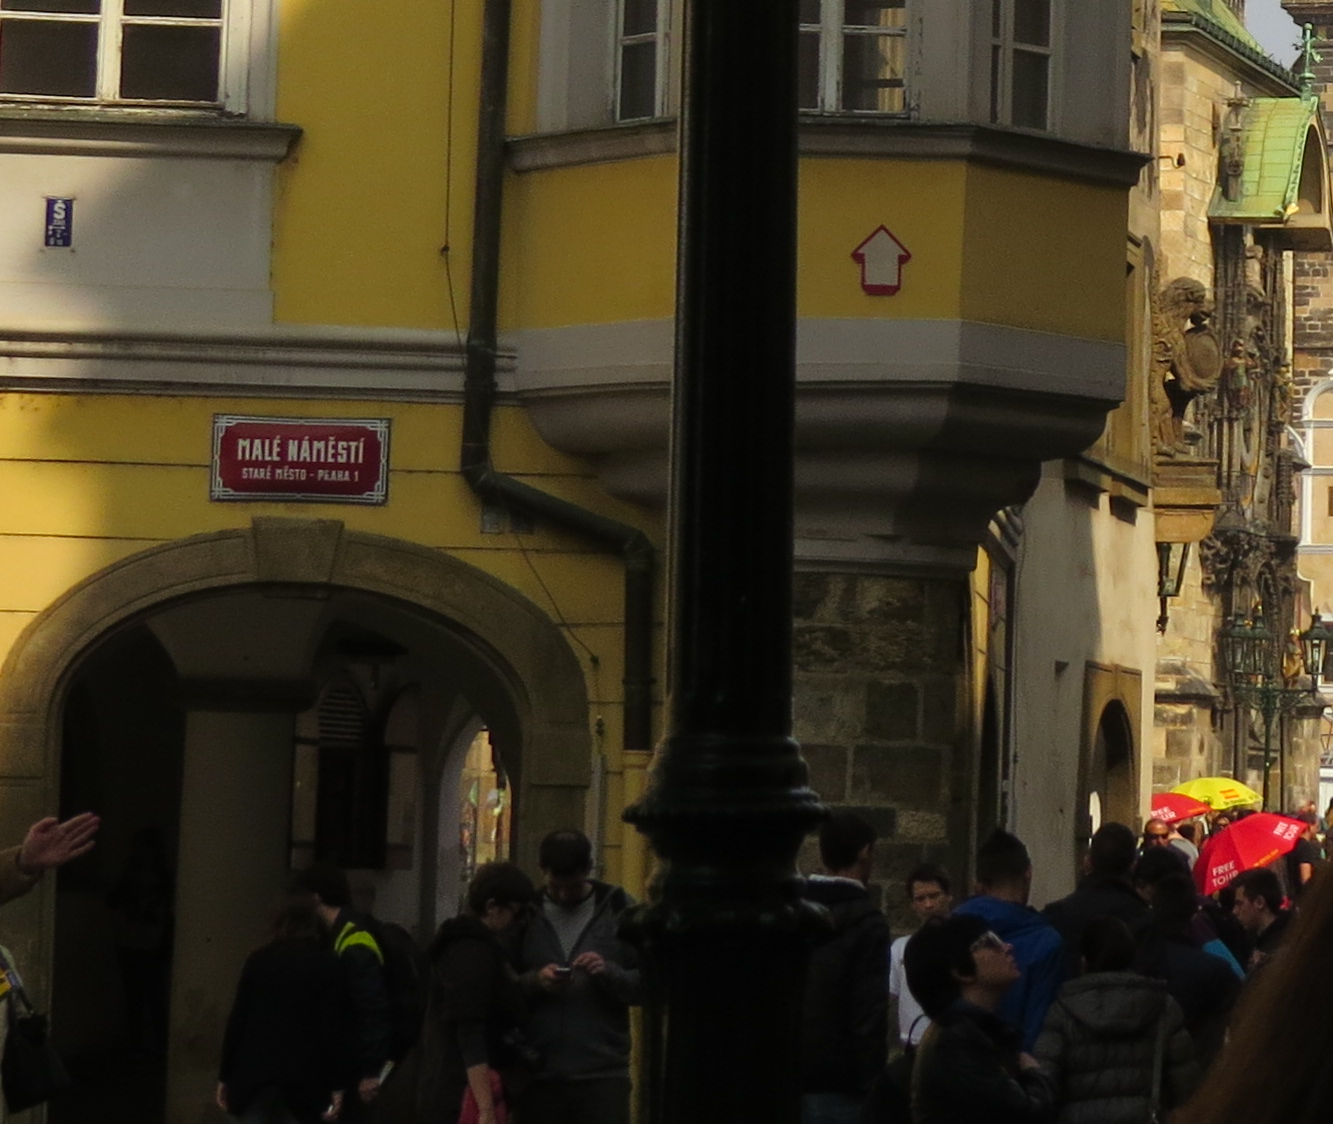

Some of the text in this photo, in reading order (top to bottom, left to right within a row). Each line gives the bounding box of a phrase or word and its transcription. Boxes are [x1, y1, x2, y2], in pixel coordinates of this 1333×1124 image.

[237, 435, 365, 464] MALÉ NÁMĚSTÍ
[242, 465, 272, 479] STARÉ
[275, 465, 307, 481] MĚSTO
[318, 470, 350, 481] PRAHA
[354, 471, 358, 482] 1
[1212, 860, 1235, 876] FREE
